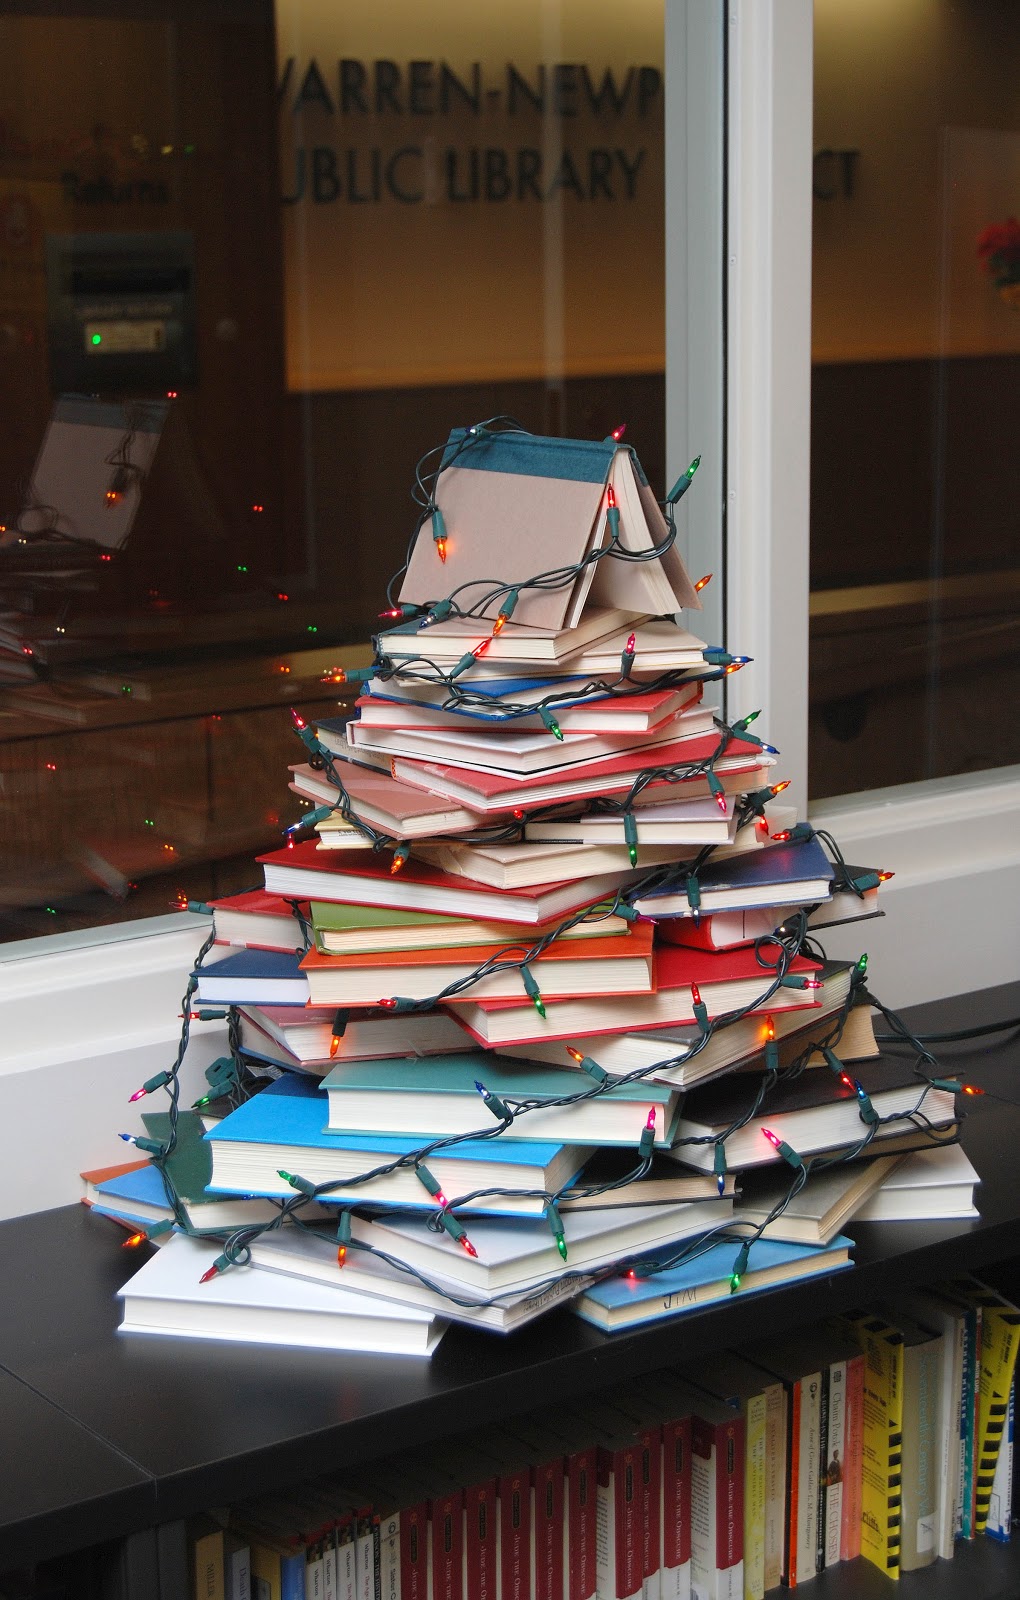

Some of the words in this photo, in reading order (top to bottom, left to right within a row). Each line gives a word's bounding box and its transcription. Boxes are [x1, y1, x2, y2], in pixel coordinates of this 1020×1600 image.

[277, 57, 662, 118] ARREN-NEWP
[443, 146, 647, 204] LIBRARY
[832, 1392, 842, 1421] Chaim
[831, 1422, 841, 1447] Potok
[829, 1485, 840, 1510] THE
[805, 1513, 813, 1550] Montgomery
[828, 1511, 840, 1560] CHOSEN
